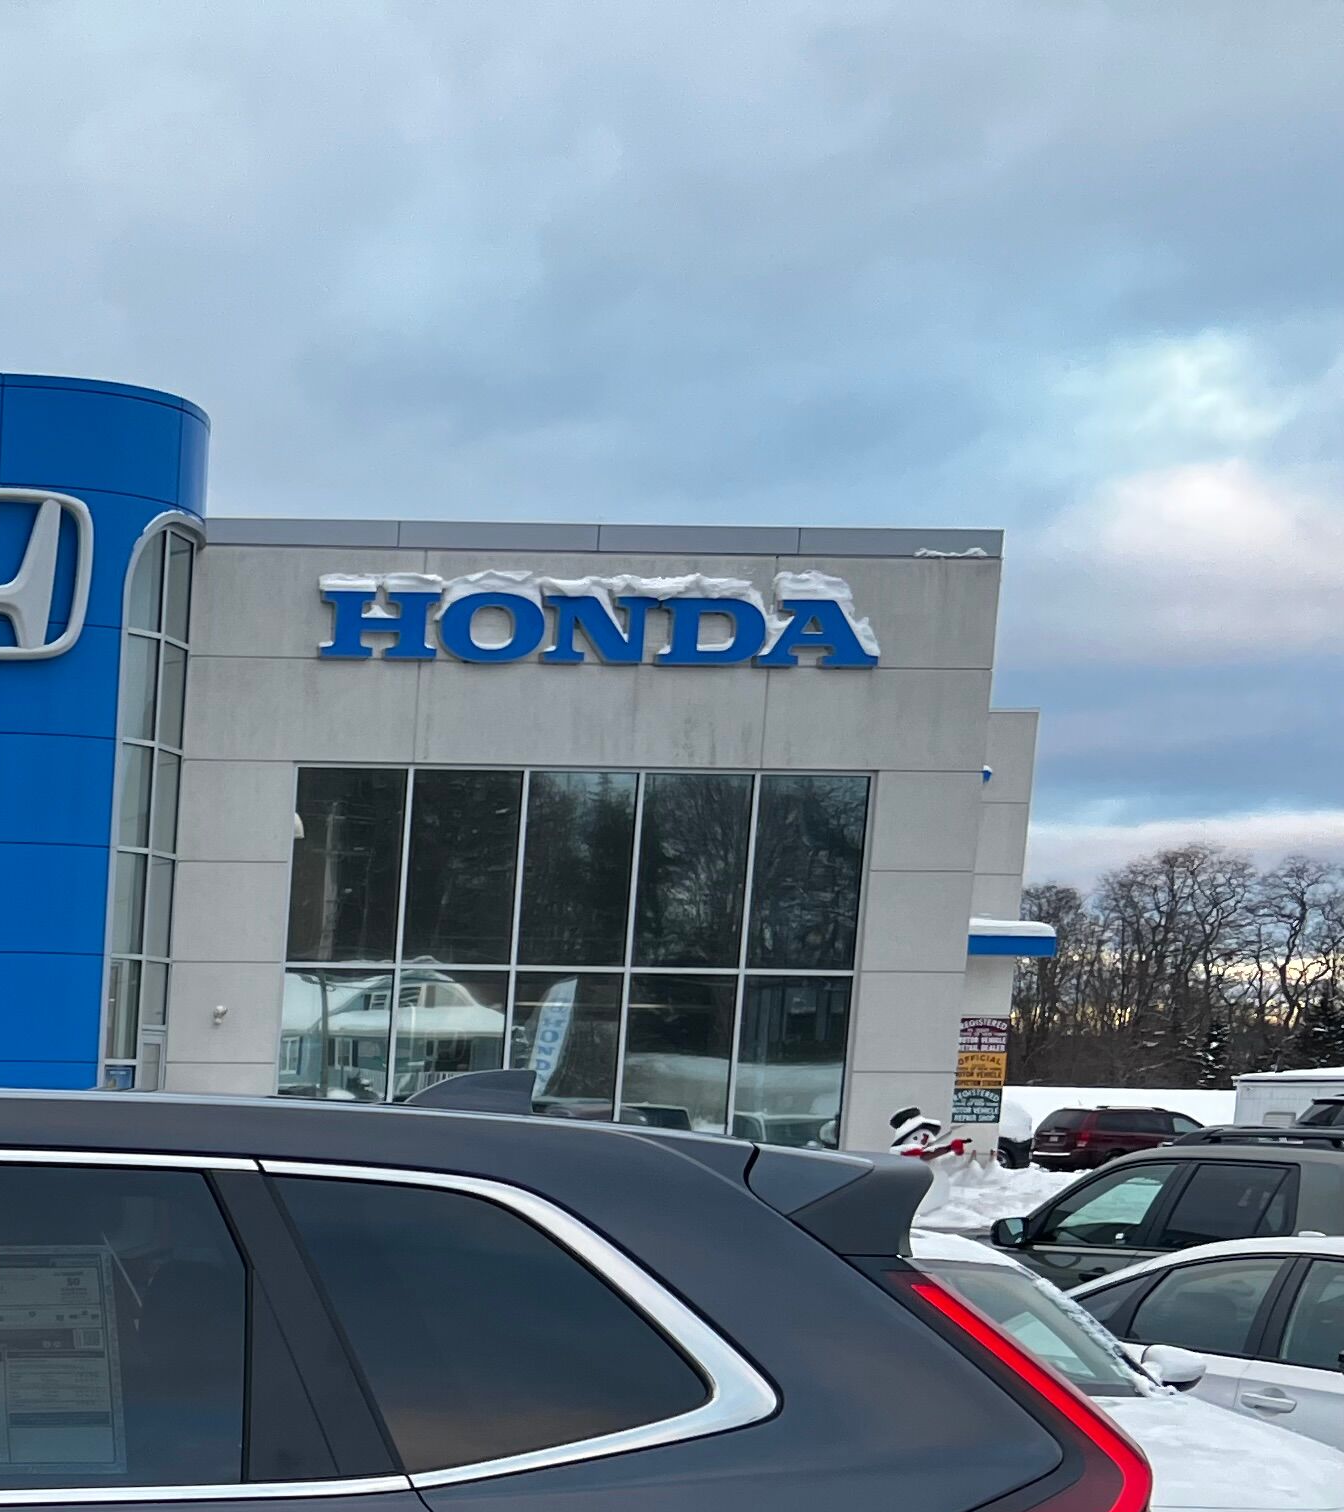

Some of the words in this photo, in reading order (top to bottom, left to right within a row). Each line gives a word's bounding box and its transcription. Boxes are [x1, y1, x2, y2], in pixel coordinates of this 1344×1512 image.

[318, 588, 880, 668] HONDA
[959, 1018, 1008, 1030] REGISTERED
[958, 1055, 1001, 1065] OFFICIAL
[953, 1090, 1000, 1102] REGISTERED
